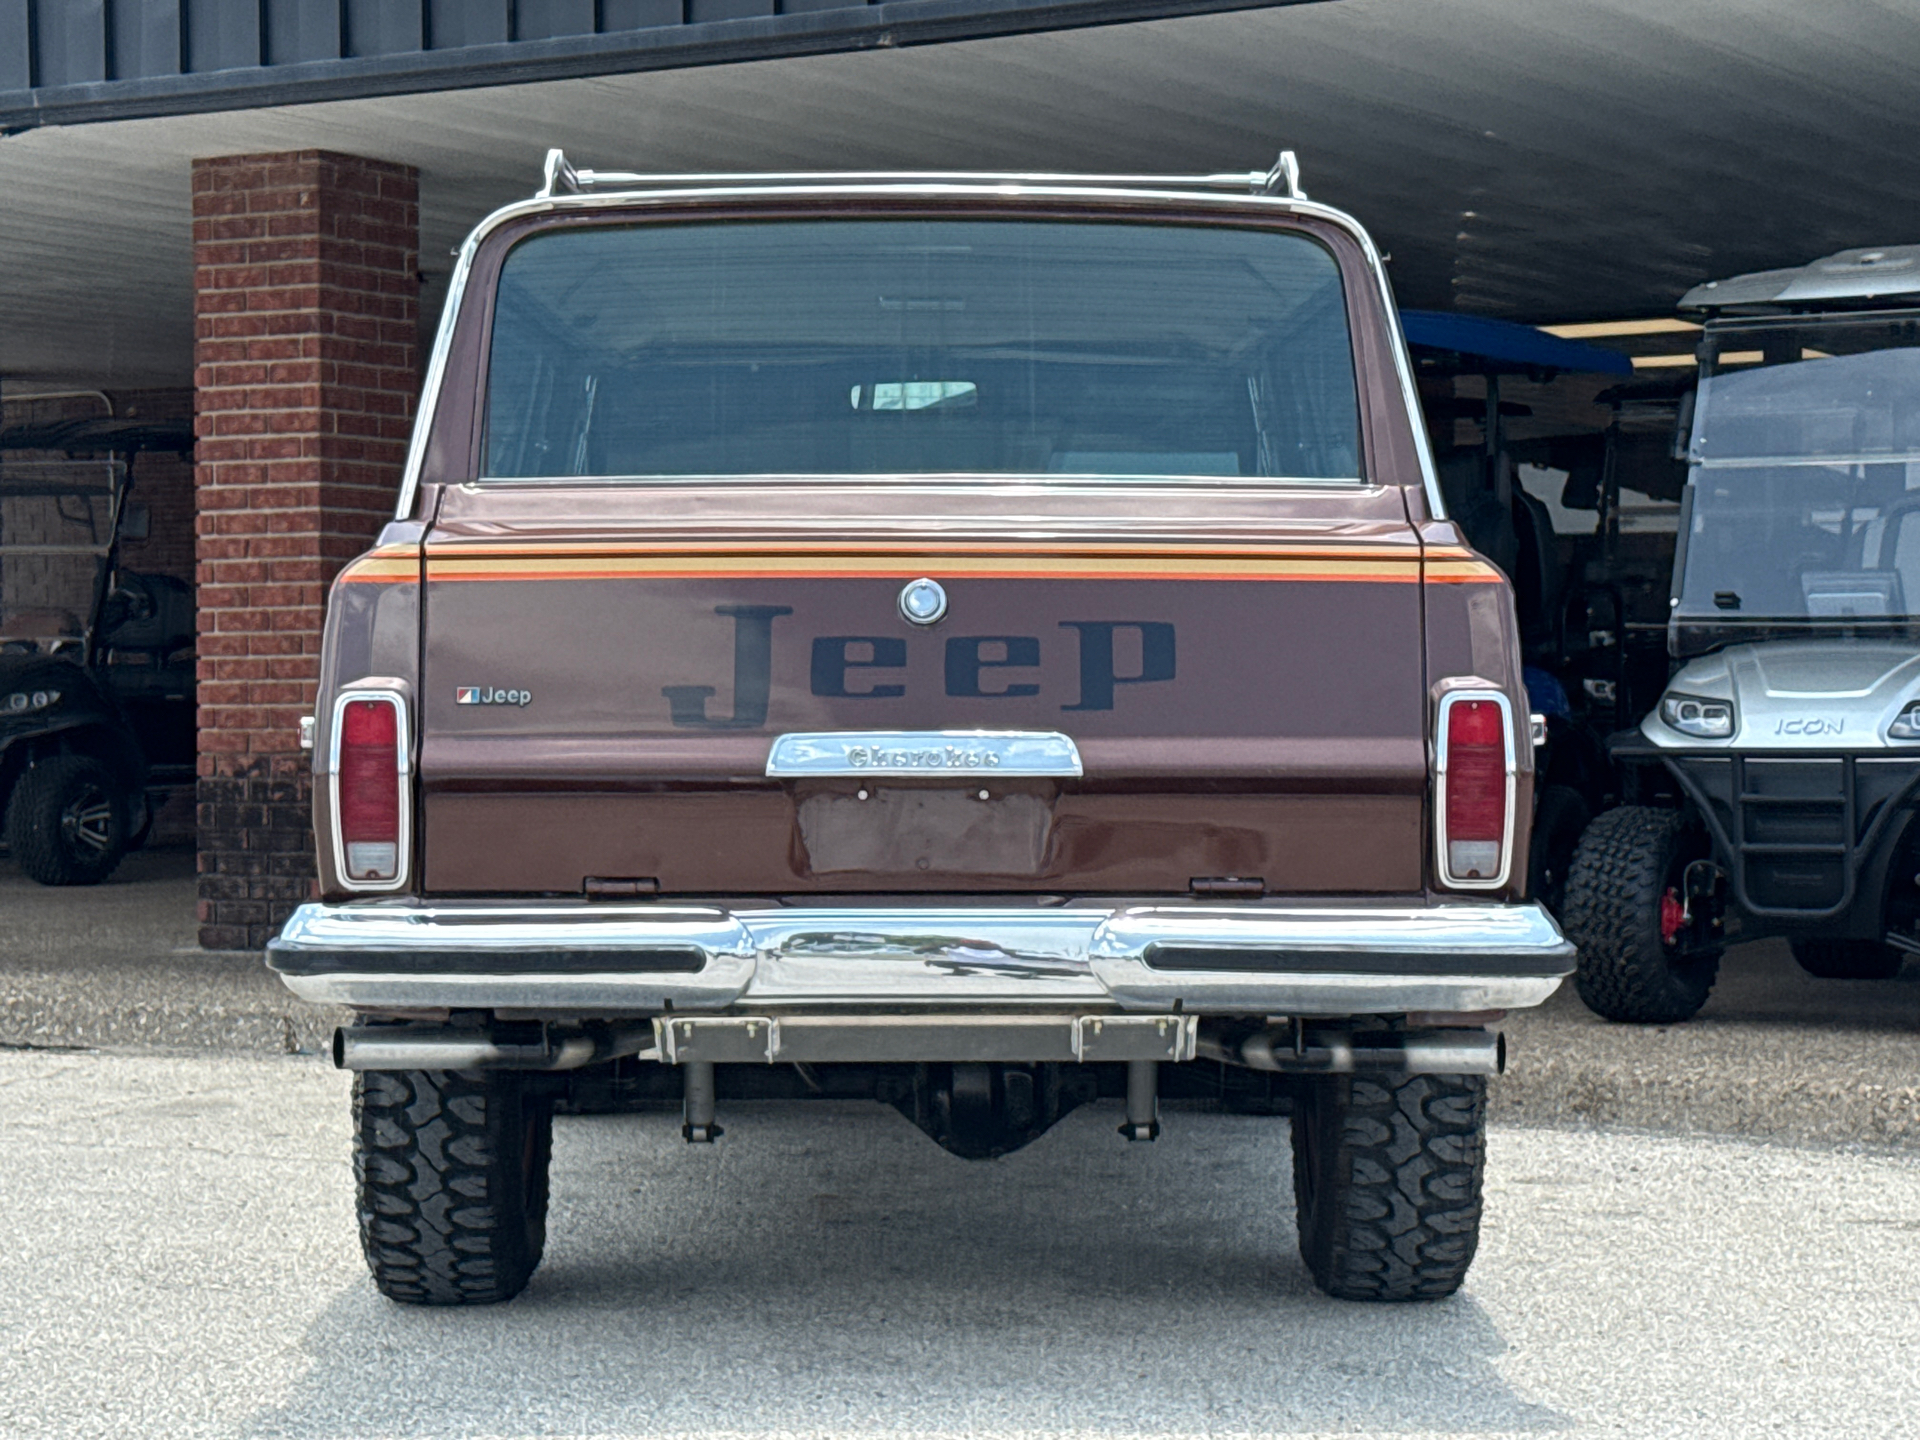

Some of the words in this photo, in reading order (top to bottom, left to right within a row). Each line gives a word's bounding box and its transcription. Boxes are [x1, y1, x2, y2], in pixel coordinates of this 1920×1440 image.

[661, 605, 1176, 728] Jeep
[481, 686, 532, 706] Jeep
[1774, 718, 1844, 735] ICON
[848, 745, 1000, 767] Cherokee
